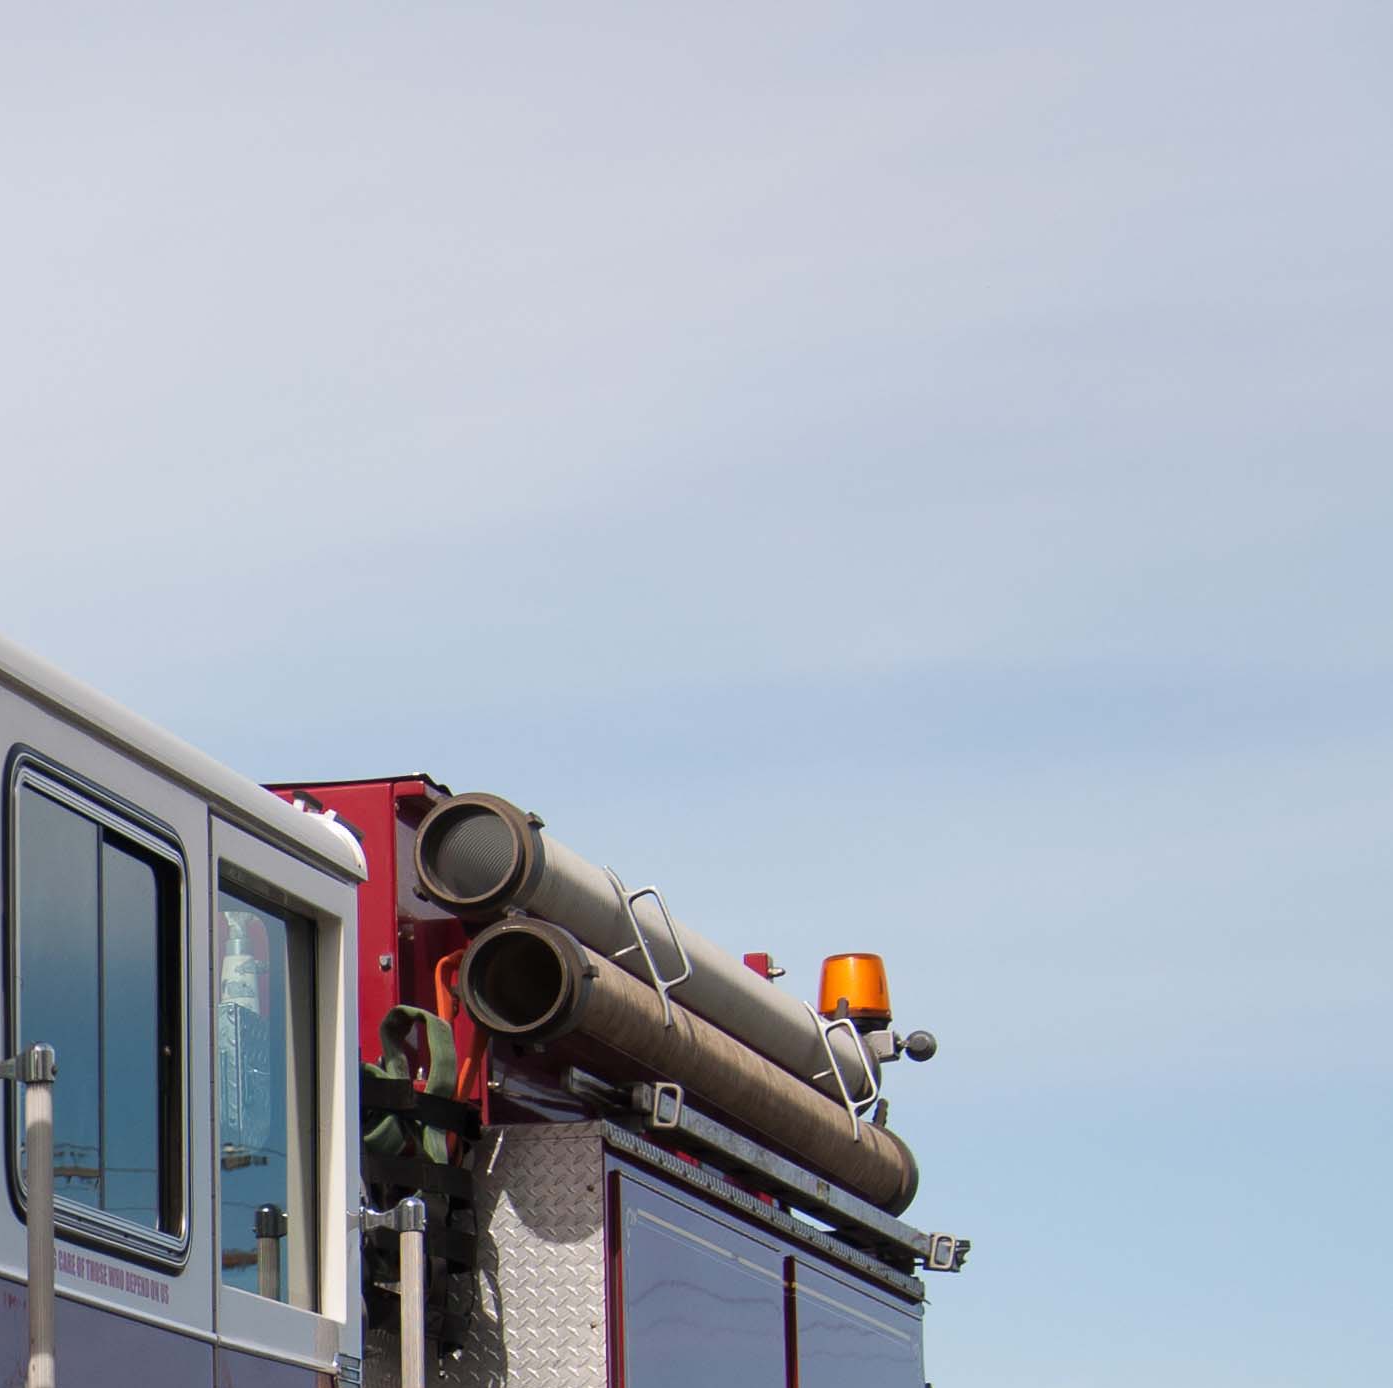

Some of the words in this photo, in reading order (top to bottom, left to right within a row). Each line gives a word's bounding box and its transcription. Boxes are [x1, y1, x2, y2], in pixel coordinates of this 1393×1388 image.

[58, 1250, 75, 1276] CARE
[86, 1259, 107, 1286] THOSE
[108, 1264, 124, 1291] WHO
[126, 1271, 149, 1298] DEPEND
[160, 1282, 170, 1304] US
